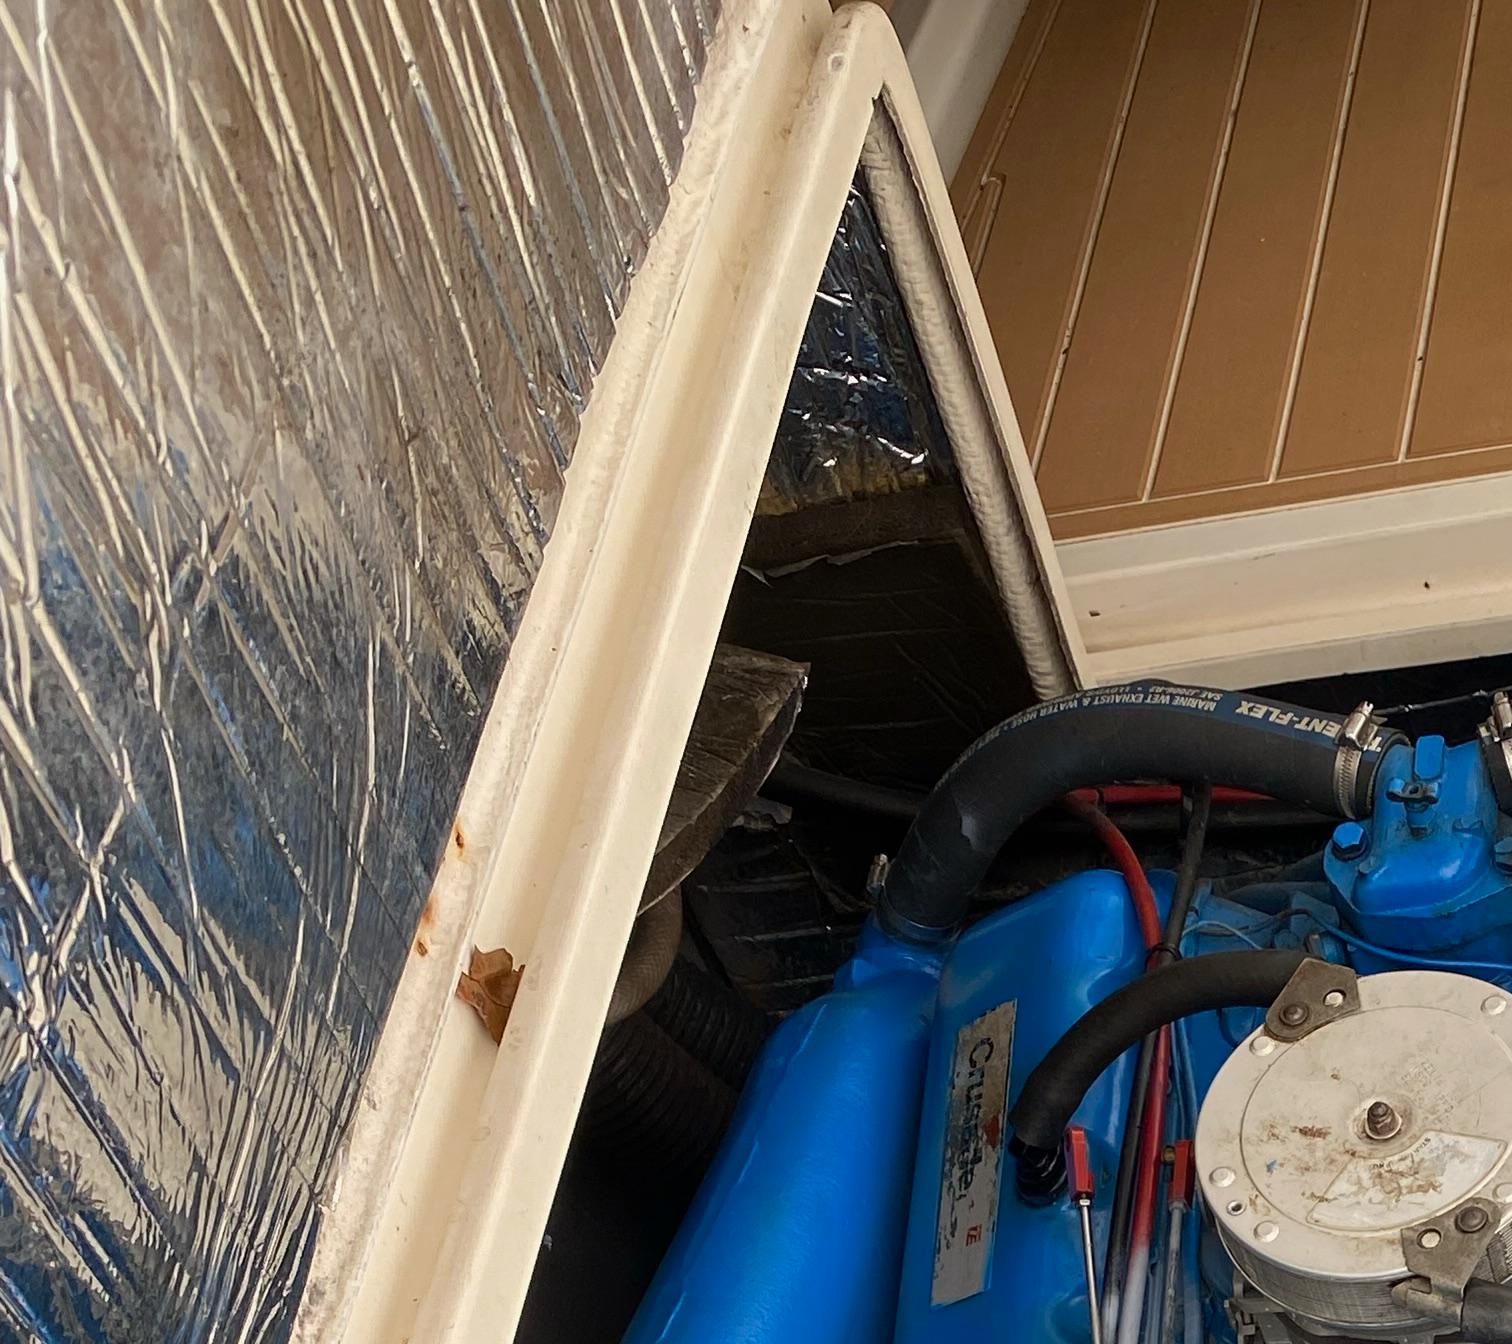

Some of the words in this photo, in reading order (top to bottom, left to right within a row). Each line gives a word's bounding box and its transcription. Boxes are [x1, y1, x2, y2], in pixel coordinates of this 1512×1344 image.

[1094, 693, 1143, 706] EXHAUST
[1146, 694, 1170, 705] WET
[1200, 691, 1223, 701] SAE
[1039, 699, 1078, 717] WATER
[1174, 696, 1217, 711] MARINE
[1236, 700, 1382, 751] TENT-FLEX
